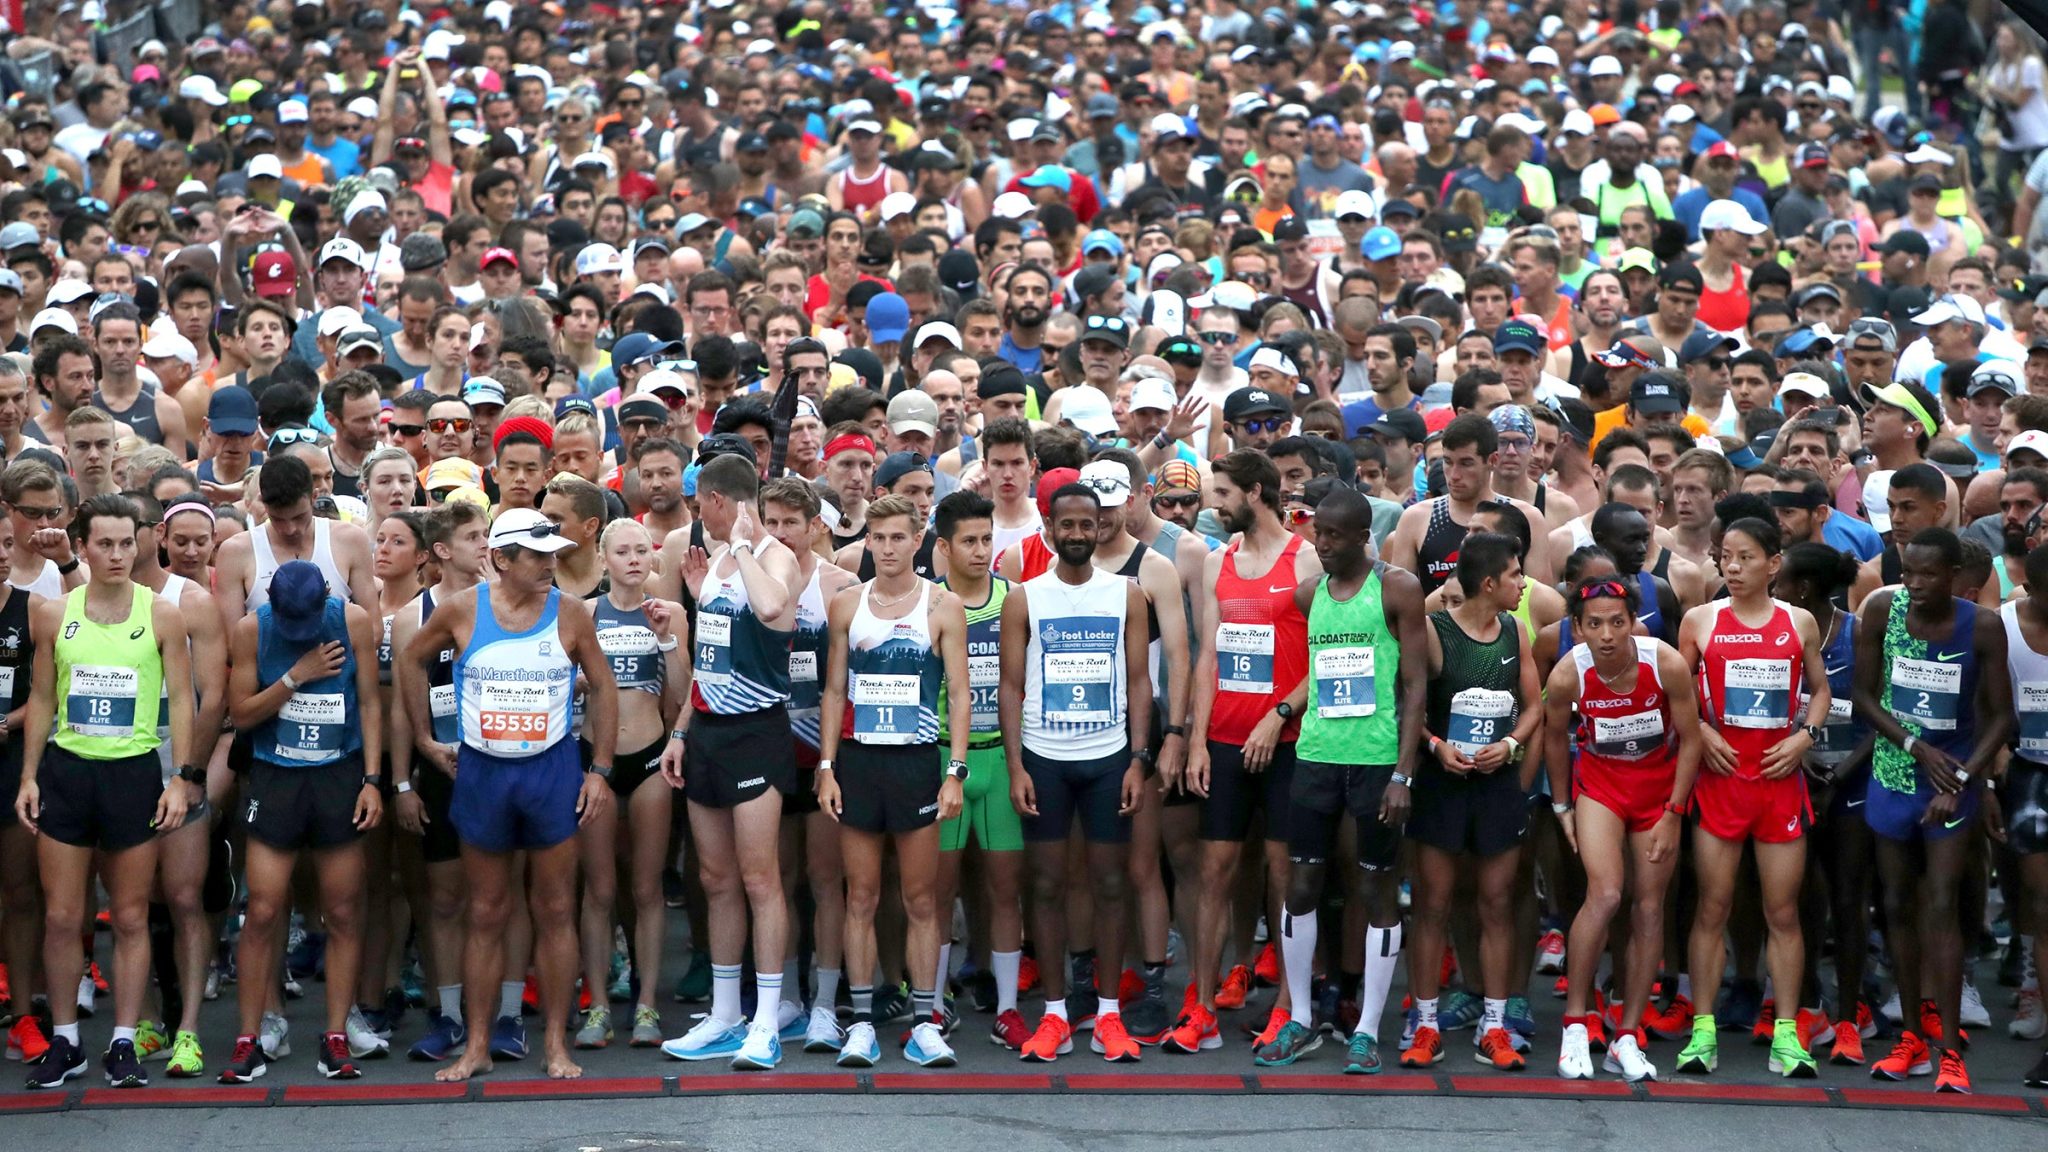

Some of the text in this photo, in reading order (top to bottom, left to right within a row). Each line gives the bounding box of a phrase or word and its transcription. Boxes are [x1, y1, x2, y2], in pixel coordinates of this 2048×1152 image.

[1062, 630, 1115, 640] Foot Locker
[1249, 629, 1270, 637] Roll
[1319, 633, 1350, 644] COAST
[701, 645, 715, 663] 46
[614, 657, 638, 673] 55
[790, 657, 812, 665] Roll
[983, 661, 1000, 669] Ro
[1232, 655, 1251, 672] 16
[1731, 662, 1788, 672] Rock Roll
[1898, 661, 1924, 672] Rock
[1934, 667, 1957, 676] Roll
[75, 670, 133, 680] Rock Roll
[481, 667, 545, 681] Marathon
[859, 679, 916, 688] Rock Roll
[1333, 679, 1351, 697] 21
[434, 690, 455, 700] Roc
[486, 686, 512, 695] Rock
[523, 687, 546, 696] Roll
[1072, 685, 1086, 702] 9
[1458, 692, 1484, 700] Rock
[319, 699, 341, 707] Roll
[1753, 691, 1766, 707] 7
[1916, 691, 1930, 709] 2
[89, 698, 112, 716] 18
[1748, 708, 1769, 716] ELITE
[1912, 708, 1933, 717] ELITE
[89, 716, 110, 724] ELITE
[876, 707, 894, 724] 11
[482, 713, 547, 732] 25536
[1469, 718, 1495, 736] 28
[1599, 715, 1658, 729] Rock Roll
[298, 725, 320, 742] 13
[1625, 741, 1639, 751] 8
